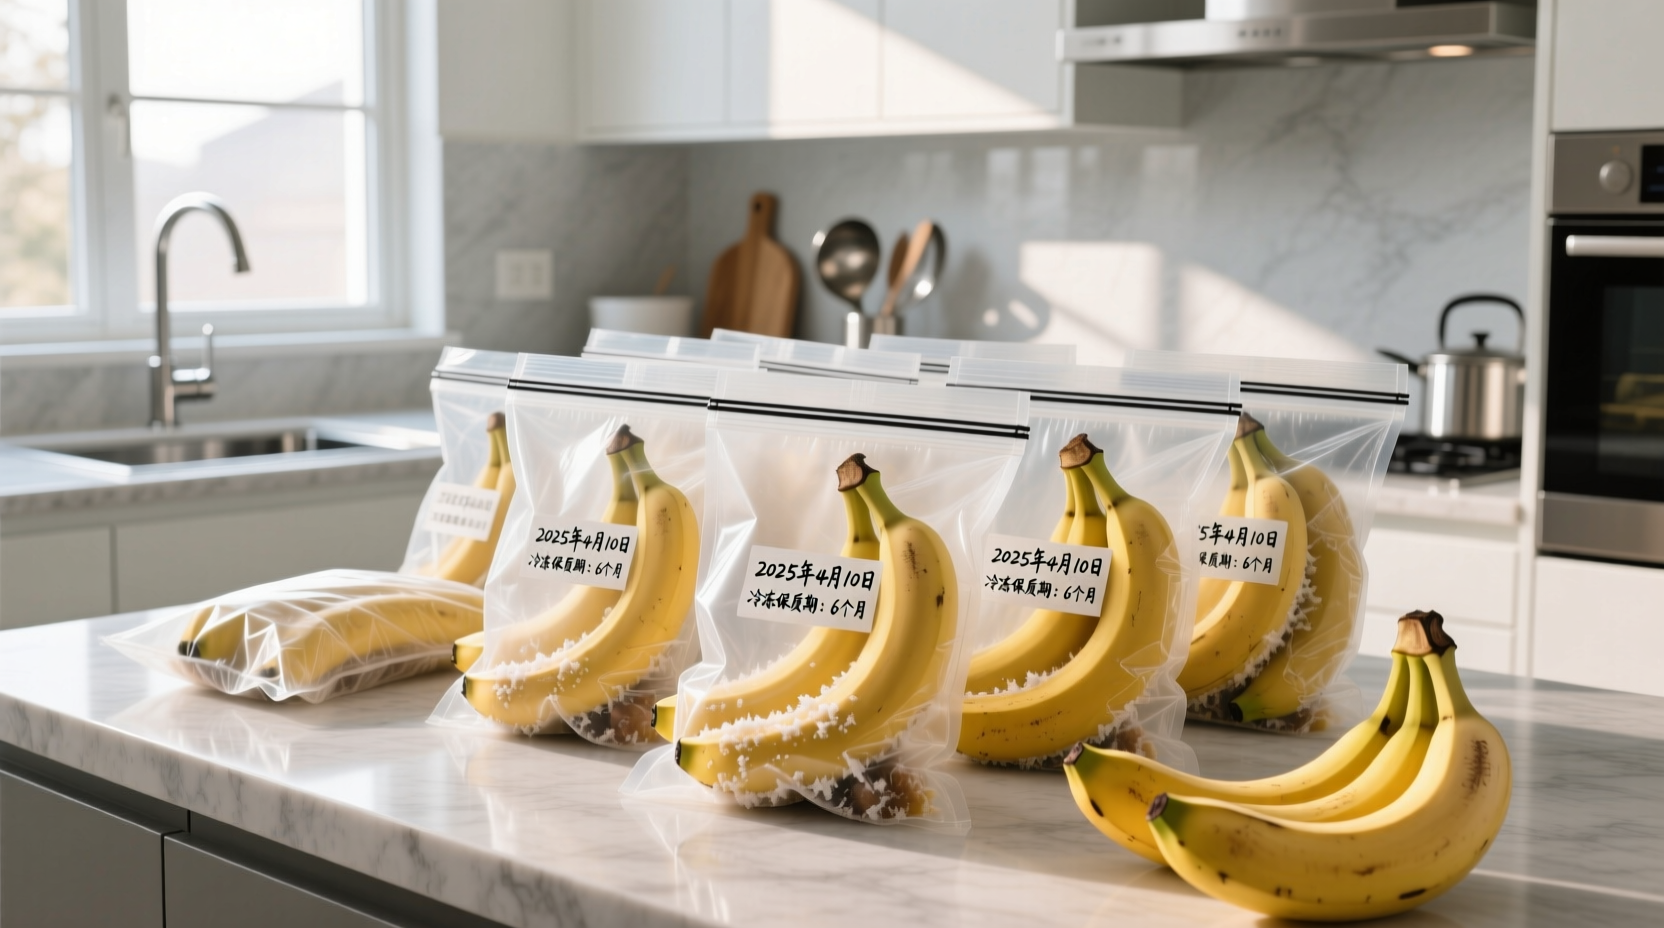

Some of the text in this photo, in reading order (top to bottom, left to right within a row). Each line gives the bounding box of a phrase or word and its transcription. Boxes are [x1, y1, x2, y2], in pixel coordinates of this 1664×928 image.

[535, 526, 630, 553] 2025年4月10日
[1198, 522, 1278, 548] 5年4月10日
[754, 559, 875, 591] 2025年4月10日
[991, 547, 1103, 576] 2025年4月10日
